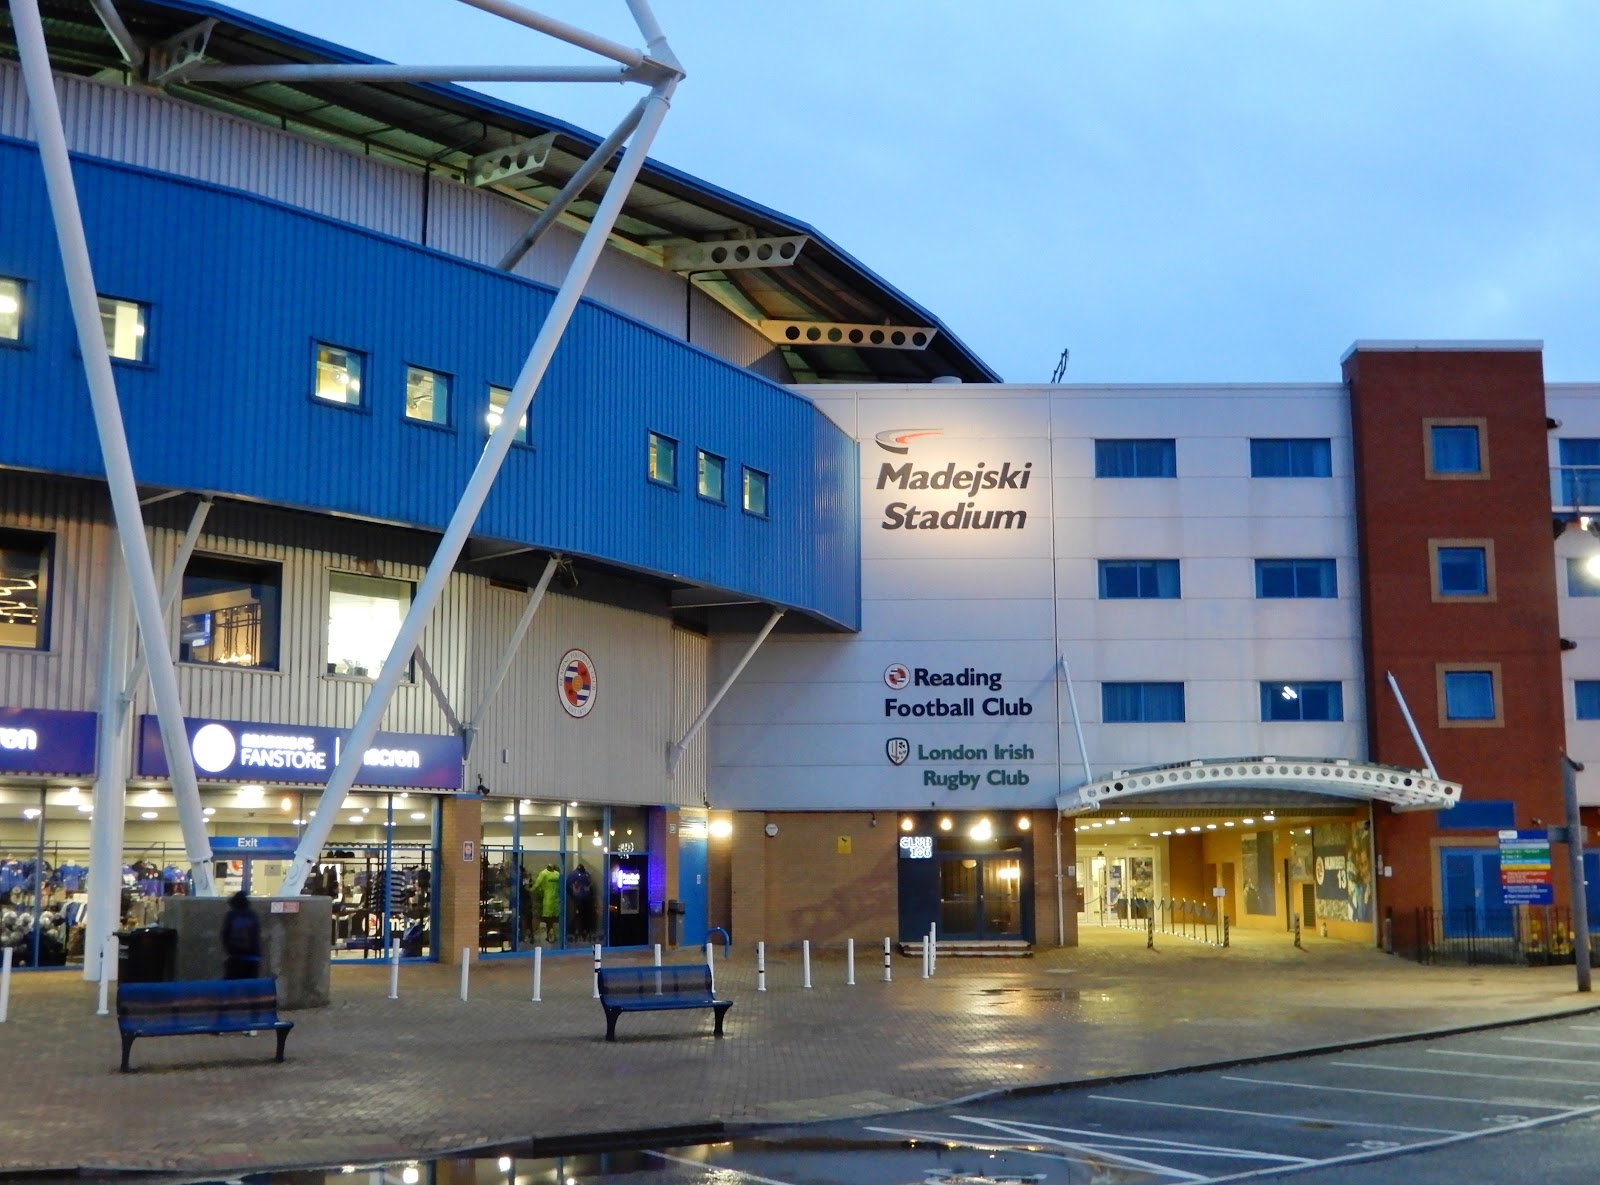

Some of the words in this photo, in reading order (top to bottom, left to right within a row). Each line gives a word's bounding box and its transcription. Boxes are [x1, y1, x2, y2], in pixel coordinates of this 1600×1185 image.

[876, 462, 1032, 497] Madejski
[881, 502, 1026, 530] Stadium
[915, 668, 1002, 691] Reading
[885, 698, 974, 717] Football
[982, 698, 1033, 716] Club
[241, 748, 326, 770] FANSTORE
[918, 745, 987, 760] London
[995, 744, 1034, 760] Irish
[924, 770, 981, 791] Rugby
[987, 769, 1030, 785] Club
[238, 837, 258, 847] Exit
[900, 836, 932, 848] CLUB
[910, 848, 932, 858] 106
[1337, 870, 1347, 888] 13
